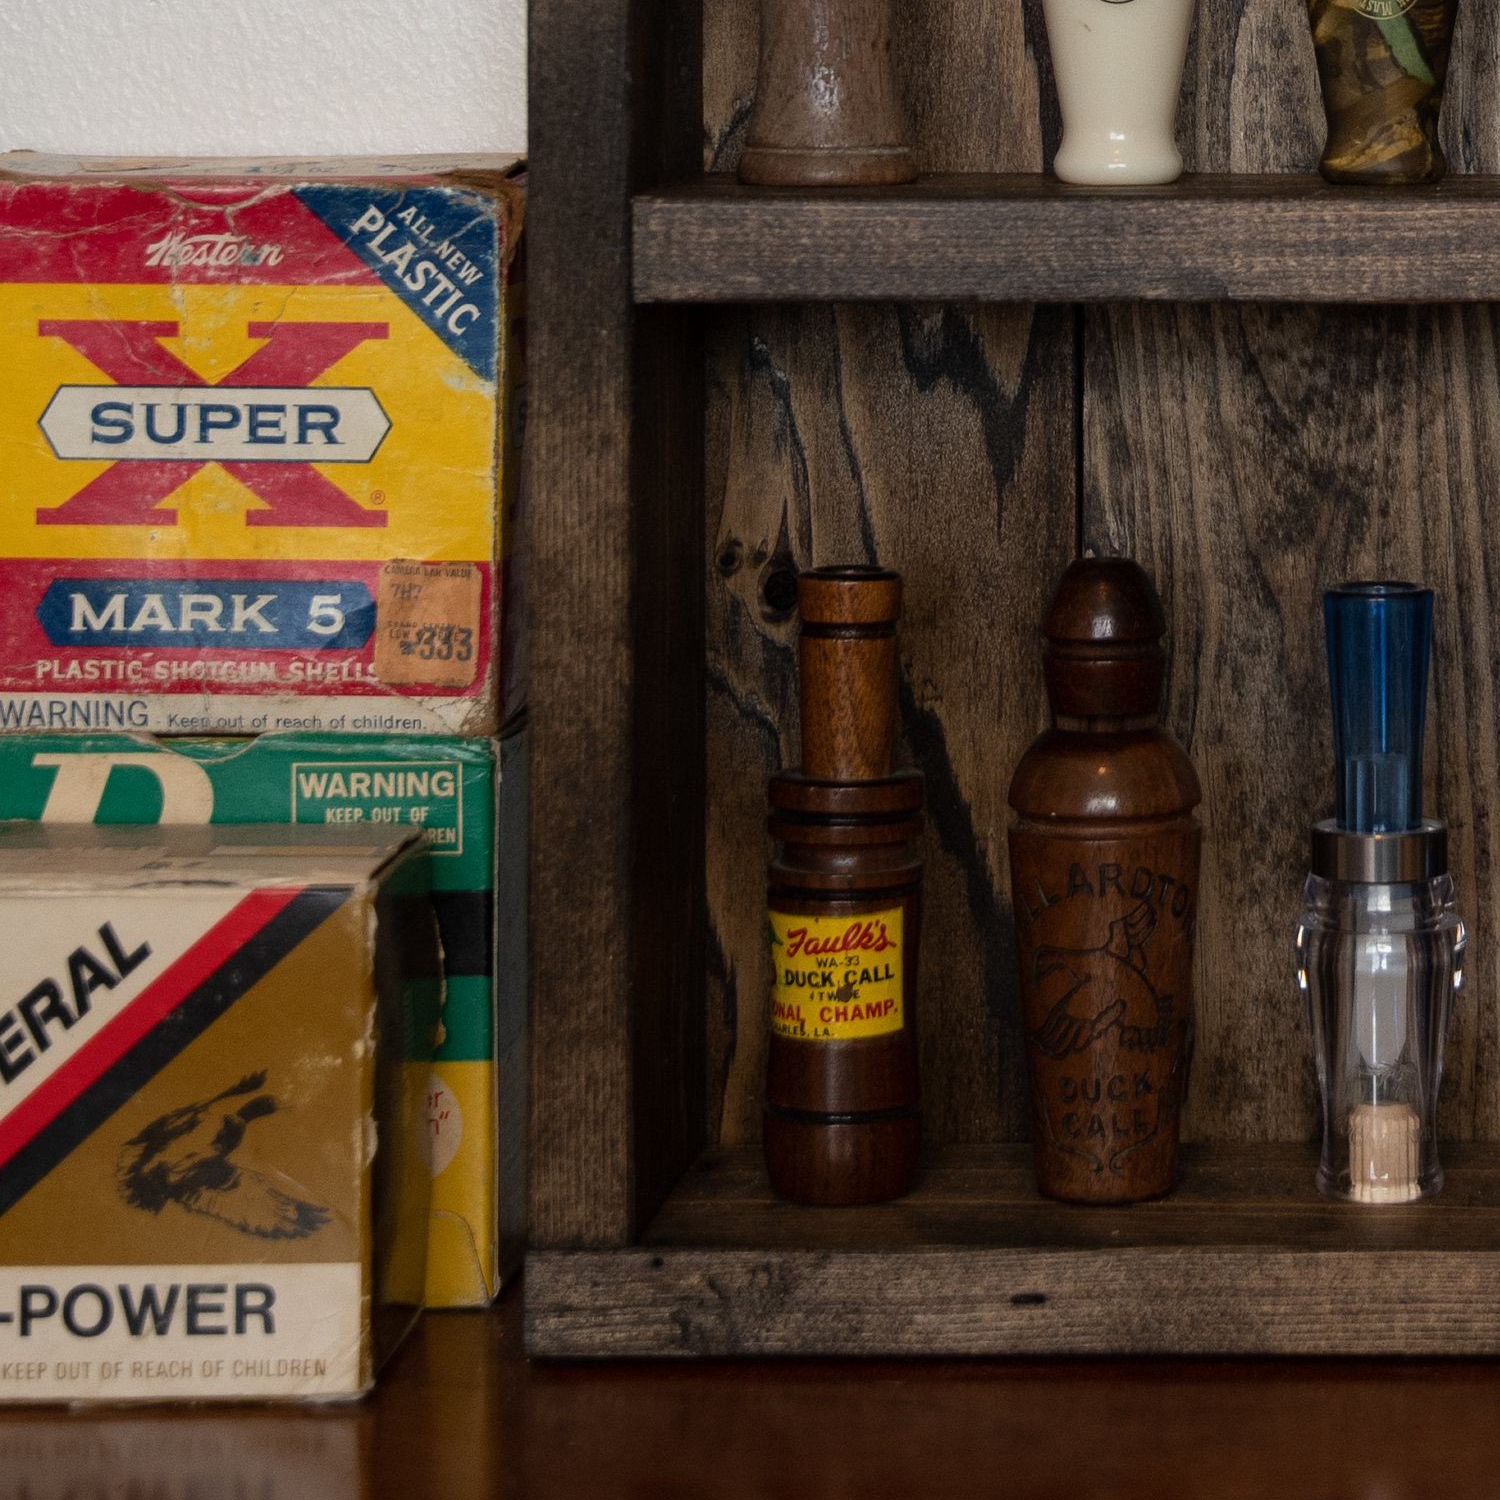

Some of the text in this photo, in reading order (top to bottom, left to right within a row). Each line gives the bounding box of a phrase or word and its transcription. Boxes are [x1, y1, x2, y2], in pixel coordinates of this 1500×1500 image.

[144, 231, 285, 268] Western
[397, 205, 484, 286] ALL NEW
[349, 203, 482, 336] PLASTIC
[91, 402, 345, 445] SUPER
[70, 593, 346, 635] MARK 5
[36, 659, 377, 683] PLASTIC SHOTGUN SHELLS
[0, 700, 427, 730] WARNING Keep out of reach of children.
[299, 771, 455, 798] WARNING
[325, 806, 429, 823] KEEP OUT OF
[787, 919, 897, 958] Faulk's
[785, 963, 895, 987] DUCK CALL
[816, 955, 860, 968] WA-33
[820, 998, 898, 1023] CHAMP.
[1059, 1069, 1153, 1104] DUCK
[1061, 1109, 1151, 1141] CALL
[2, 1358, 327, 1381] KEEP OUT OF REACH OF CHILDREN
